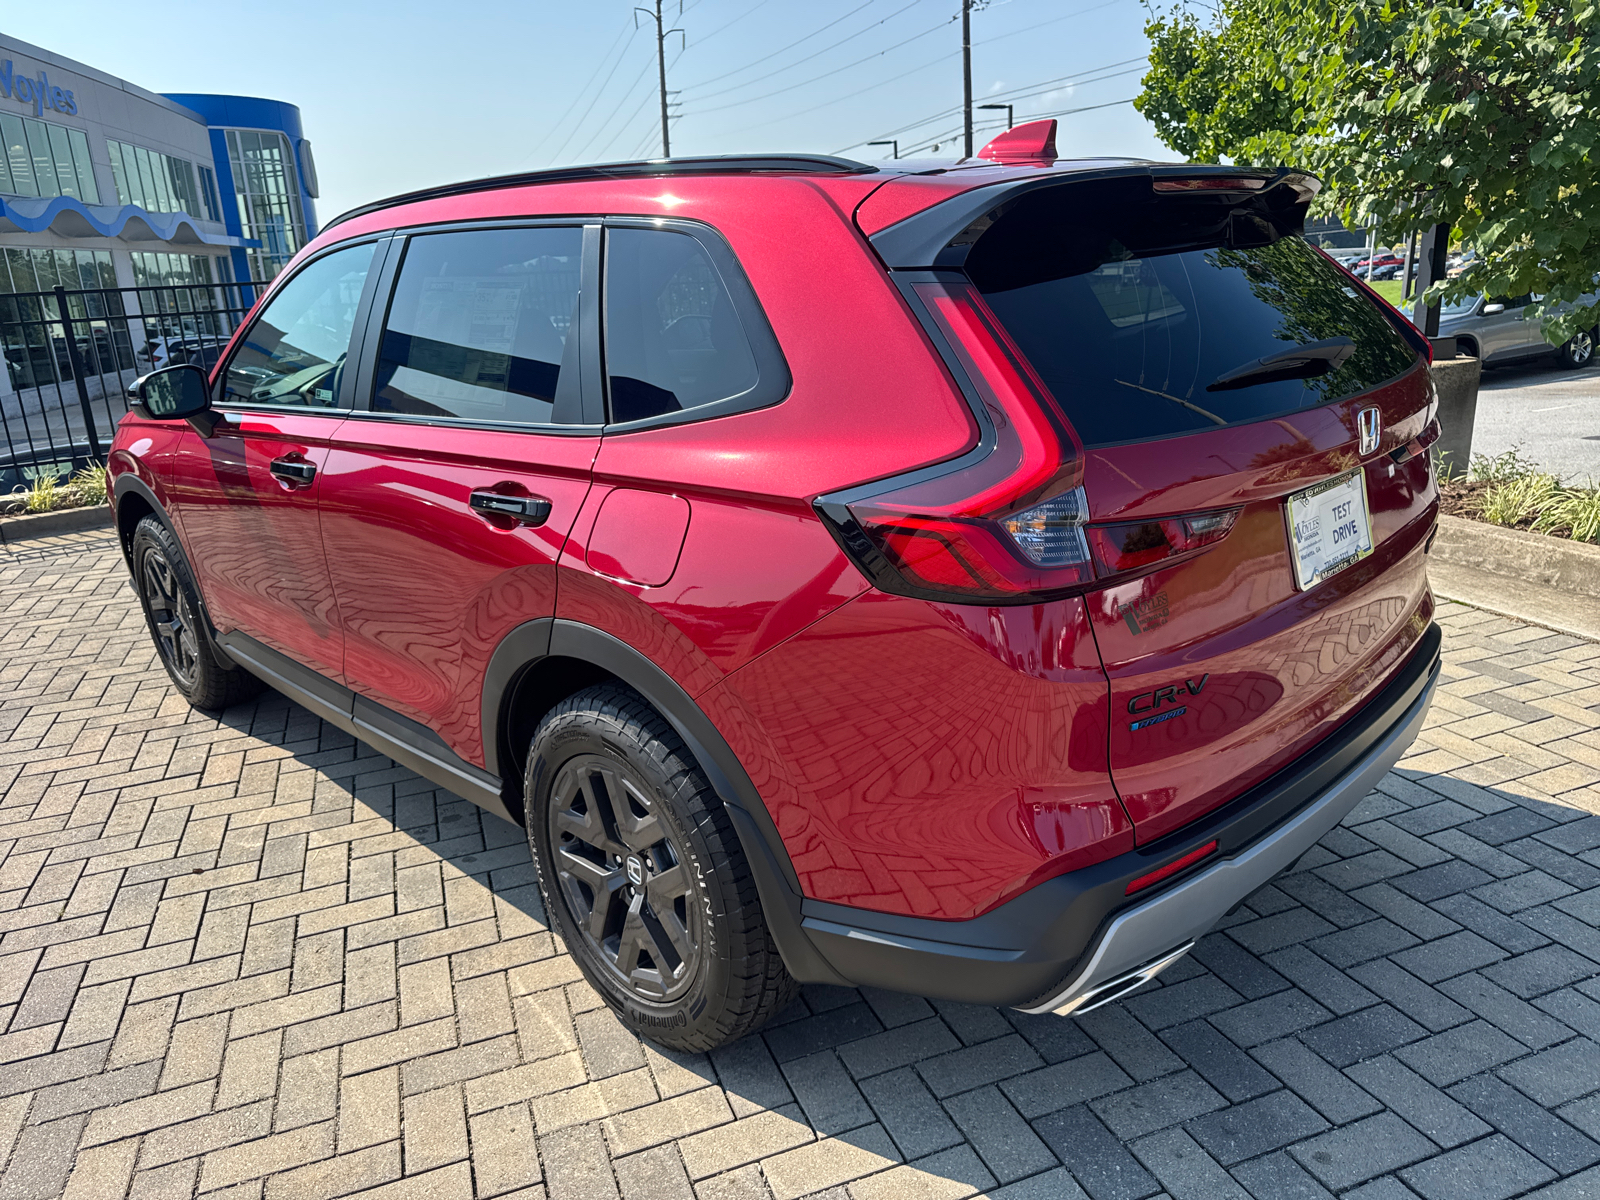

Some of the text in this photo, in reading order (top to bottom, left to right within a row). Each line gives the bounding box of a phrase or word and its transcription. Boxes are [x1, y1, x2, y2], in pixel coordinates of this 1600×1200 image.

[0, 60, 78, 117] Voyles
[1332, 500, 1351, 522] TEST
[1304, 531, 1319, 542] HONDA
[1332, 520, 1358, 544] DRIVE
[1349, 554, 1359, 565] GA
[1129, 593, 1168, 619] VOYLES
[1128, 673, 1209, 714] CR-V
[1139, 708, 1186, 729] HYBRID
[638, 1009, 687, 1031] Continental
